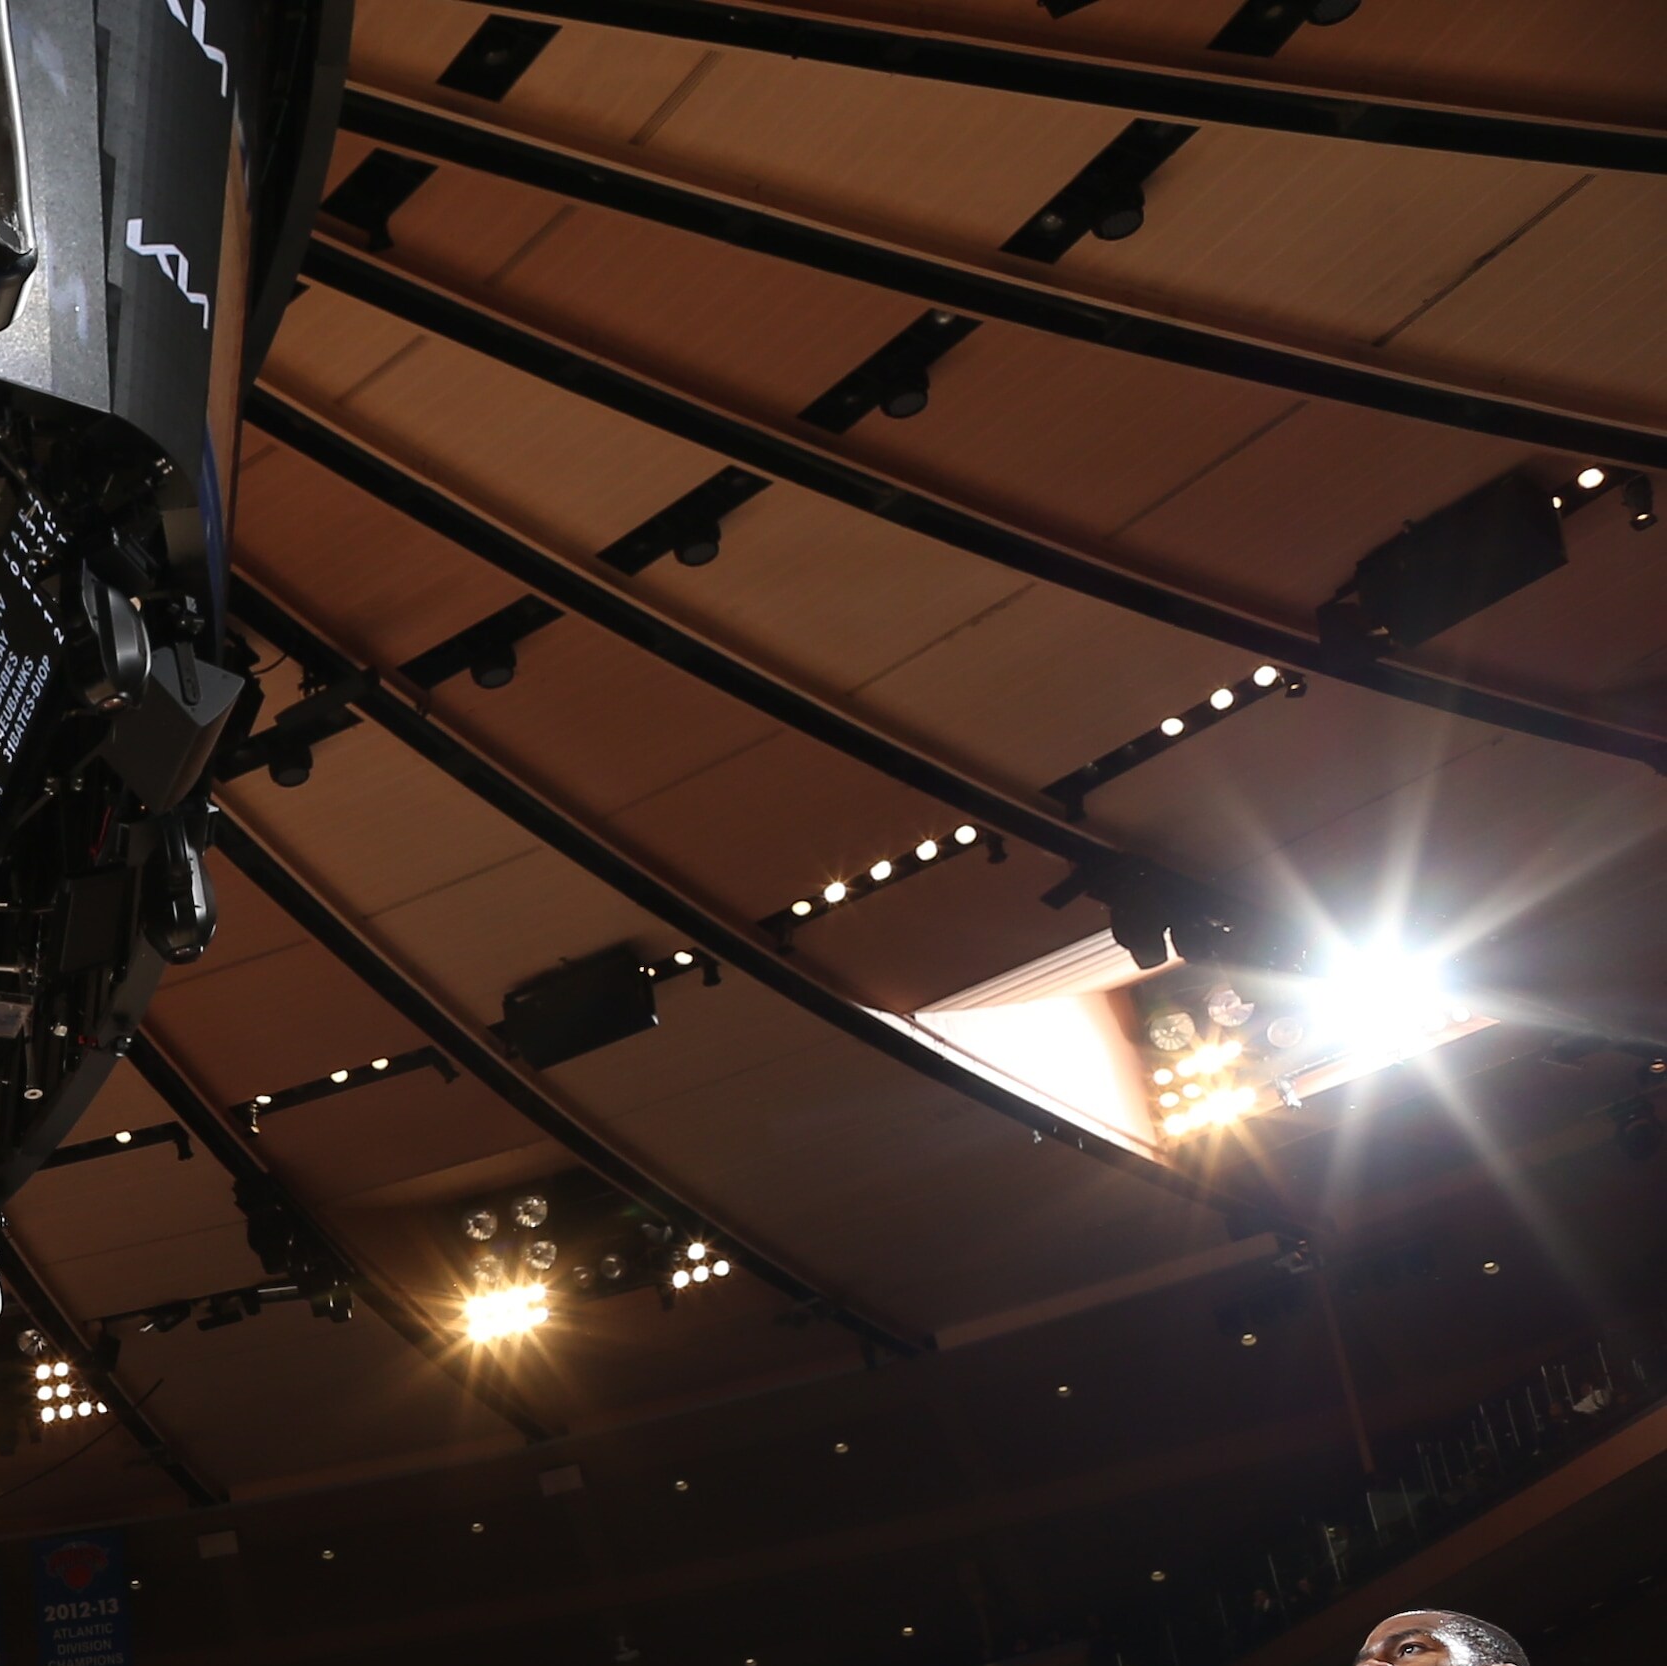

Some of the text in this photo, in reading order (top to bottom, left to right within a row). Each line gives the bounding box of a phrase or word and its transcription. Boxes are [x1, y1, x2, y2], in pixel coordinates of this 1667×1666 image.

[43, 1598, 120, 1623] 2012-13
[52, 1623, 114, 1640] ATLANTIC
[57, 1638, 112, 1655] DIVISION
